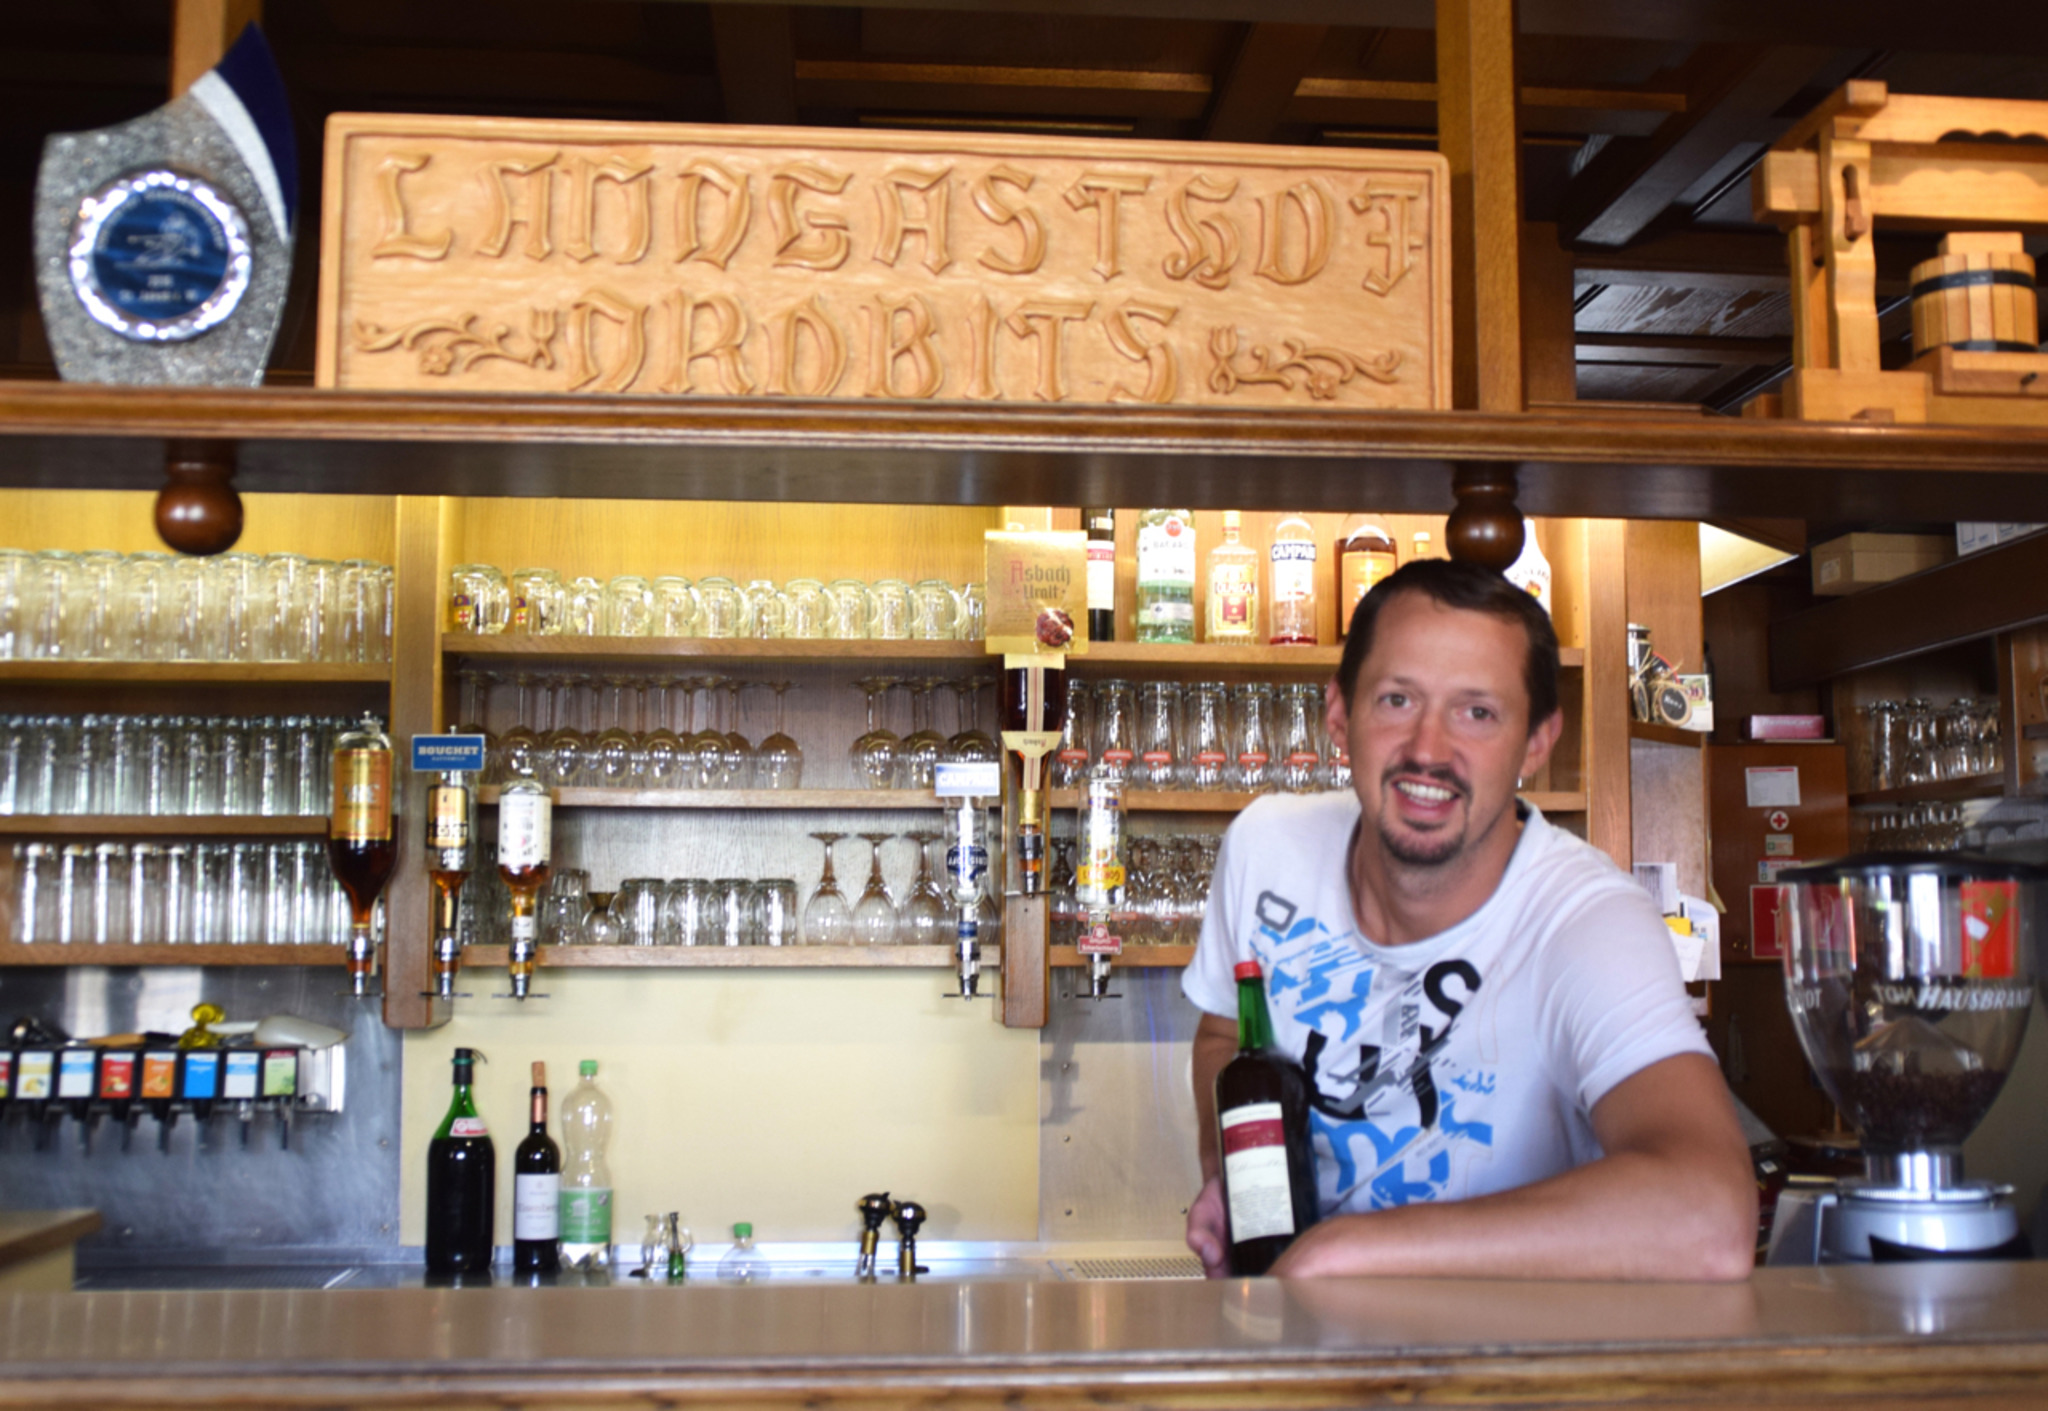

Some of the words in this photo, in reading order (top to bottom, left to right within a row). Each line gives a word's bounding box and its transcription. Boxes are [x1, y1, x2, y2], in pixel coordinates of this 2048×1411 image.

[371, 150, 1426, 294] LANDGASTHOF
[566, 289, 1181, 404] DROBITS
[1010, 561, 1070, 586] Asbach
